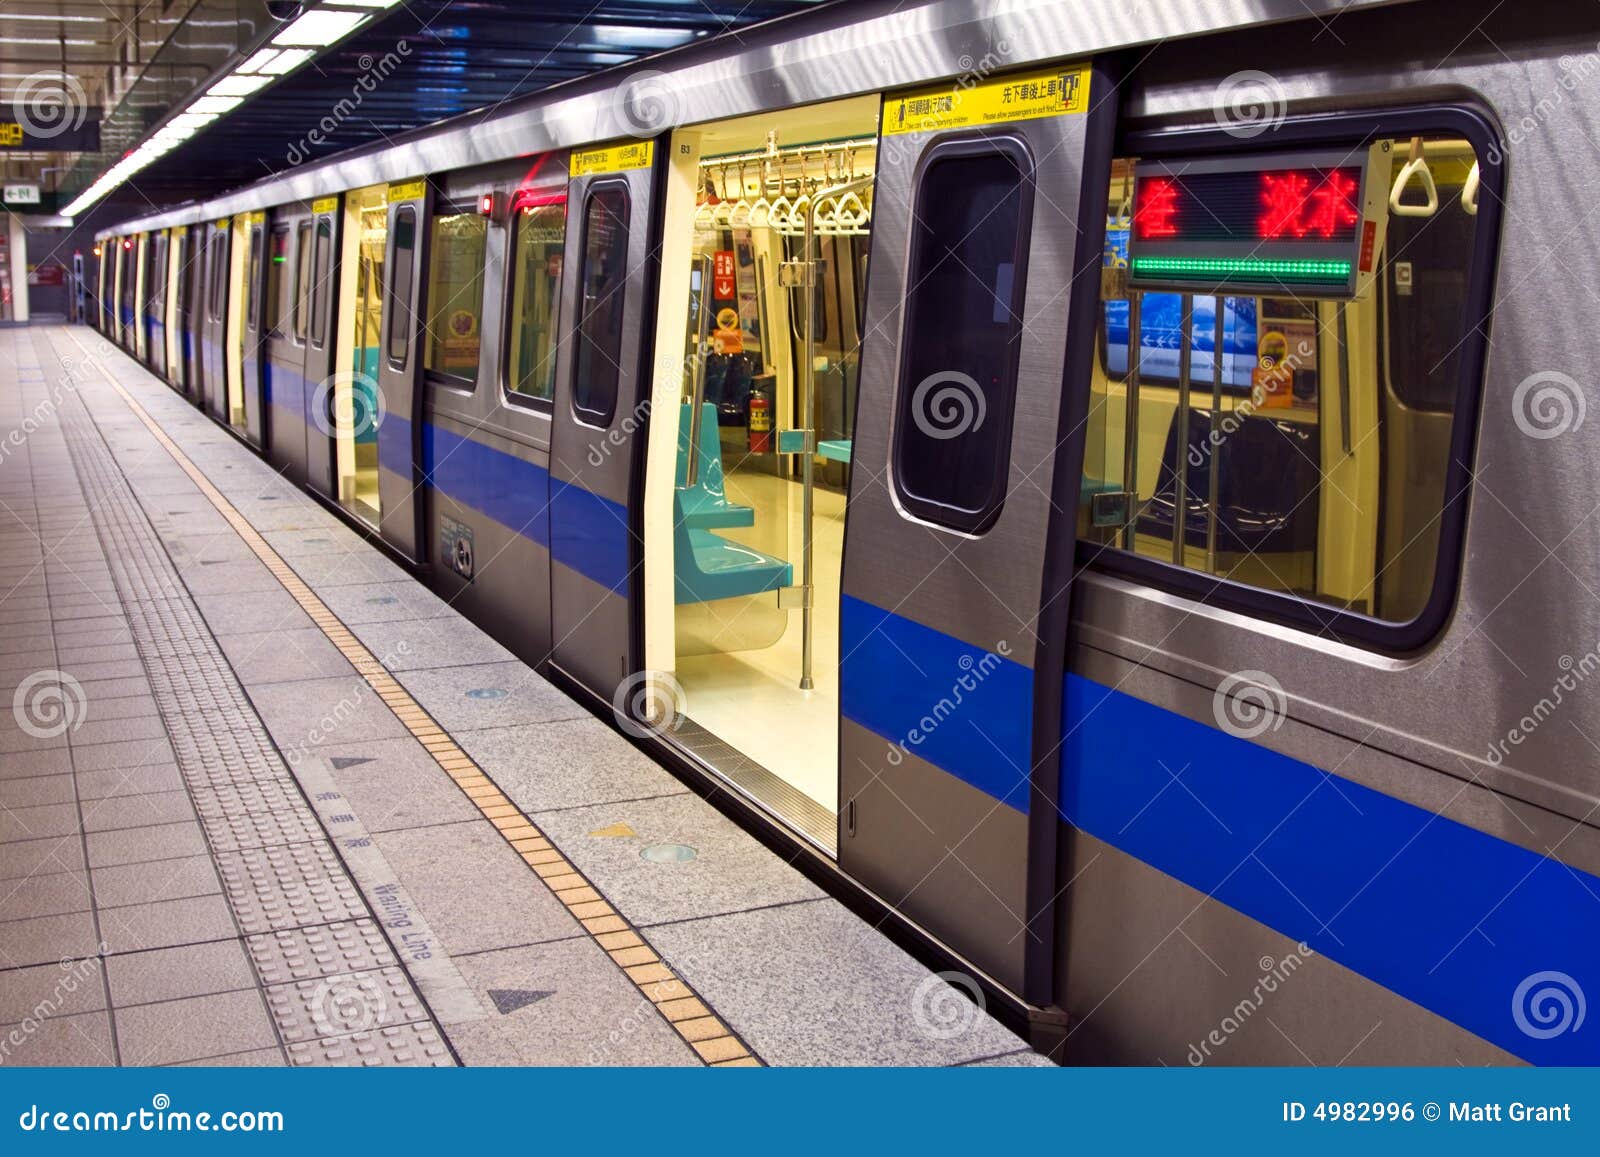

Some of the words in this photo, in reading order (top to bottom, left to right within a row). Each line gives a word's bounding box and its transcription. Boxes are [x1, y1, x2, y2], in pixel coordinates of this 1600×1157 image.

[1002, 80, 1056, 104] 先下車後上車
[681, 144, 690, 154] B3
[1259, 170, 1358, 239] 淡水
[373, 883, 413, 928] Waiting
[401, 932, 432, 960] Line
